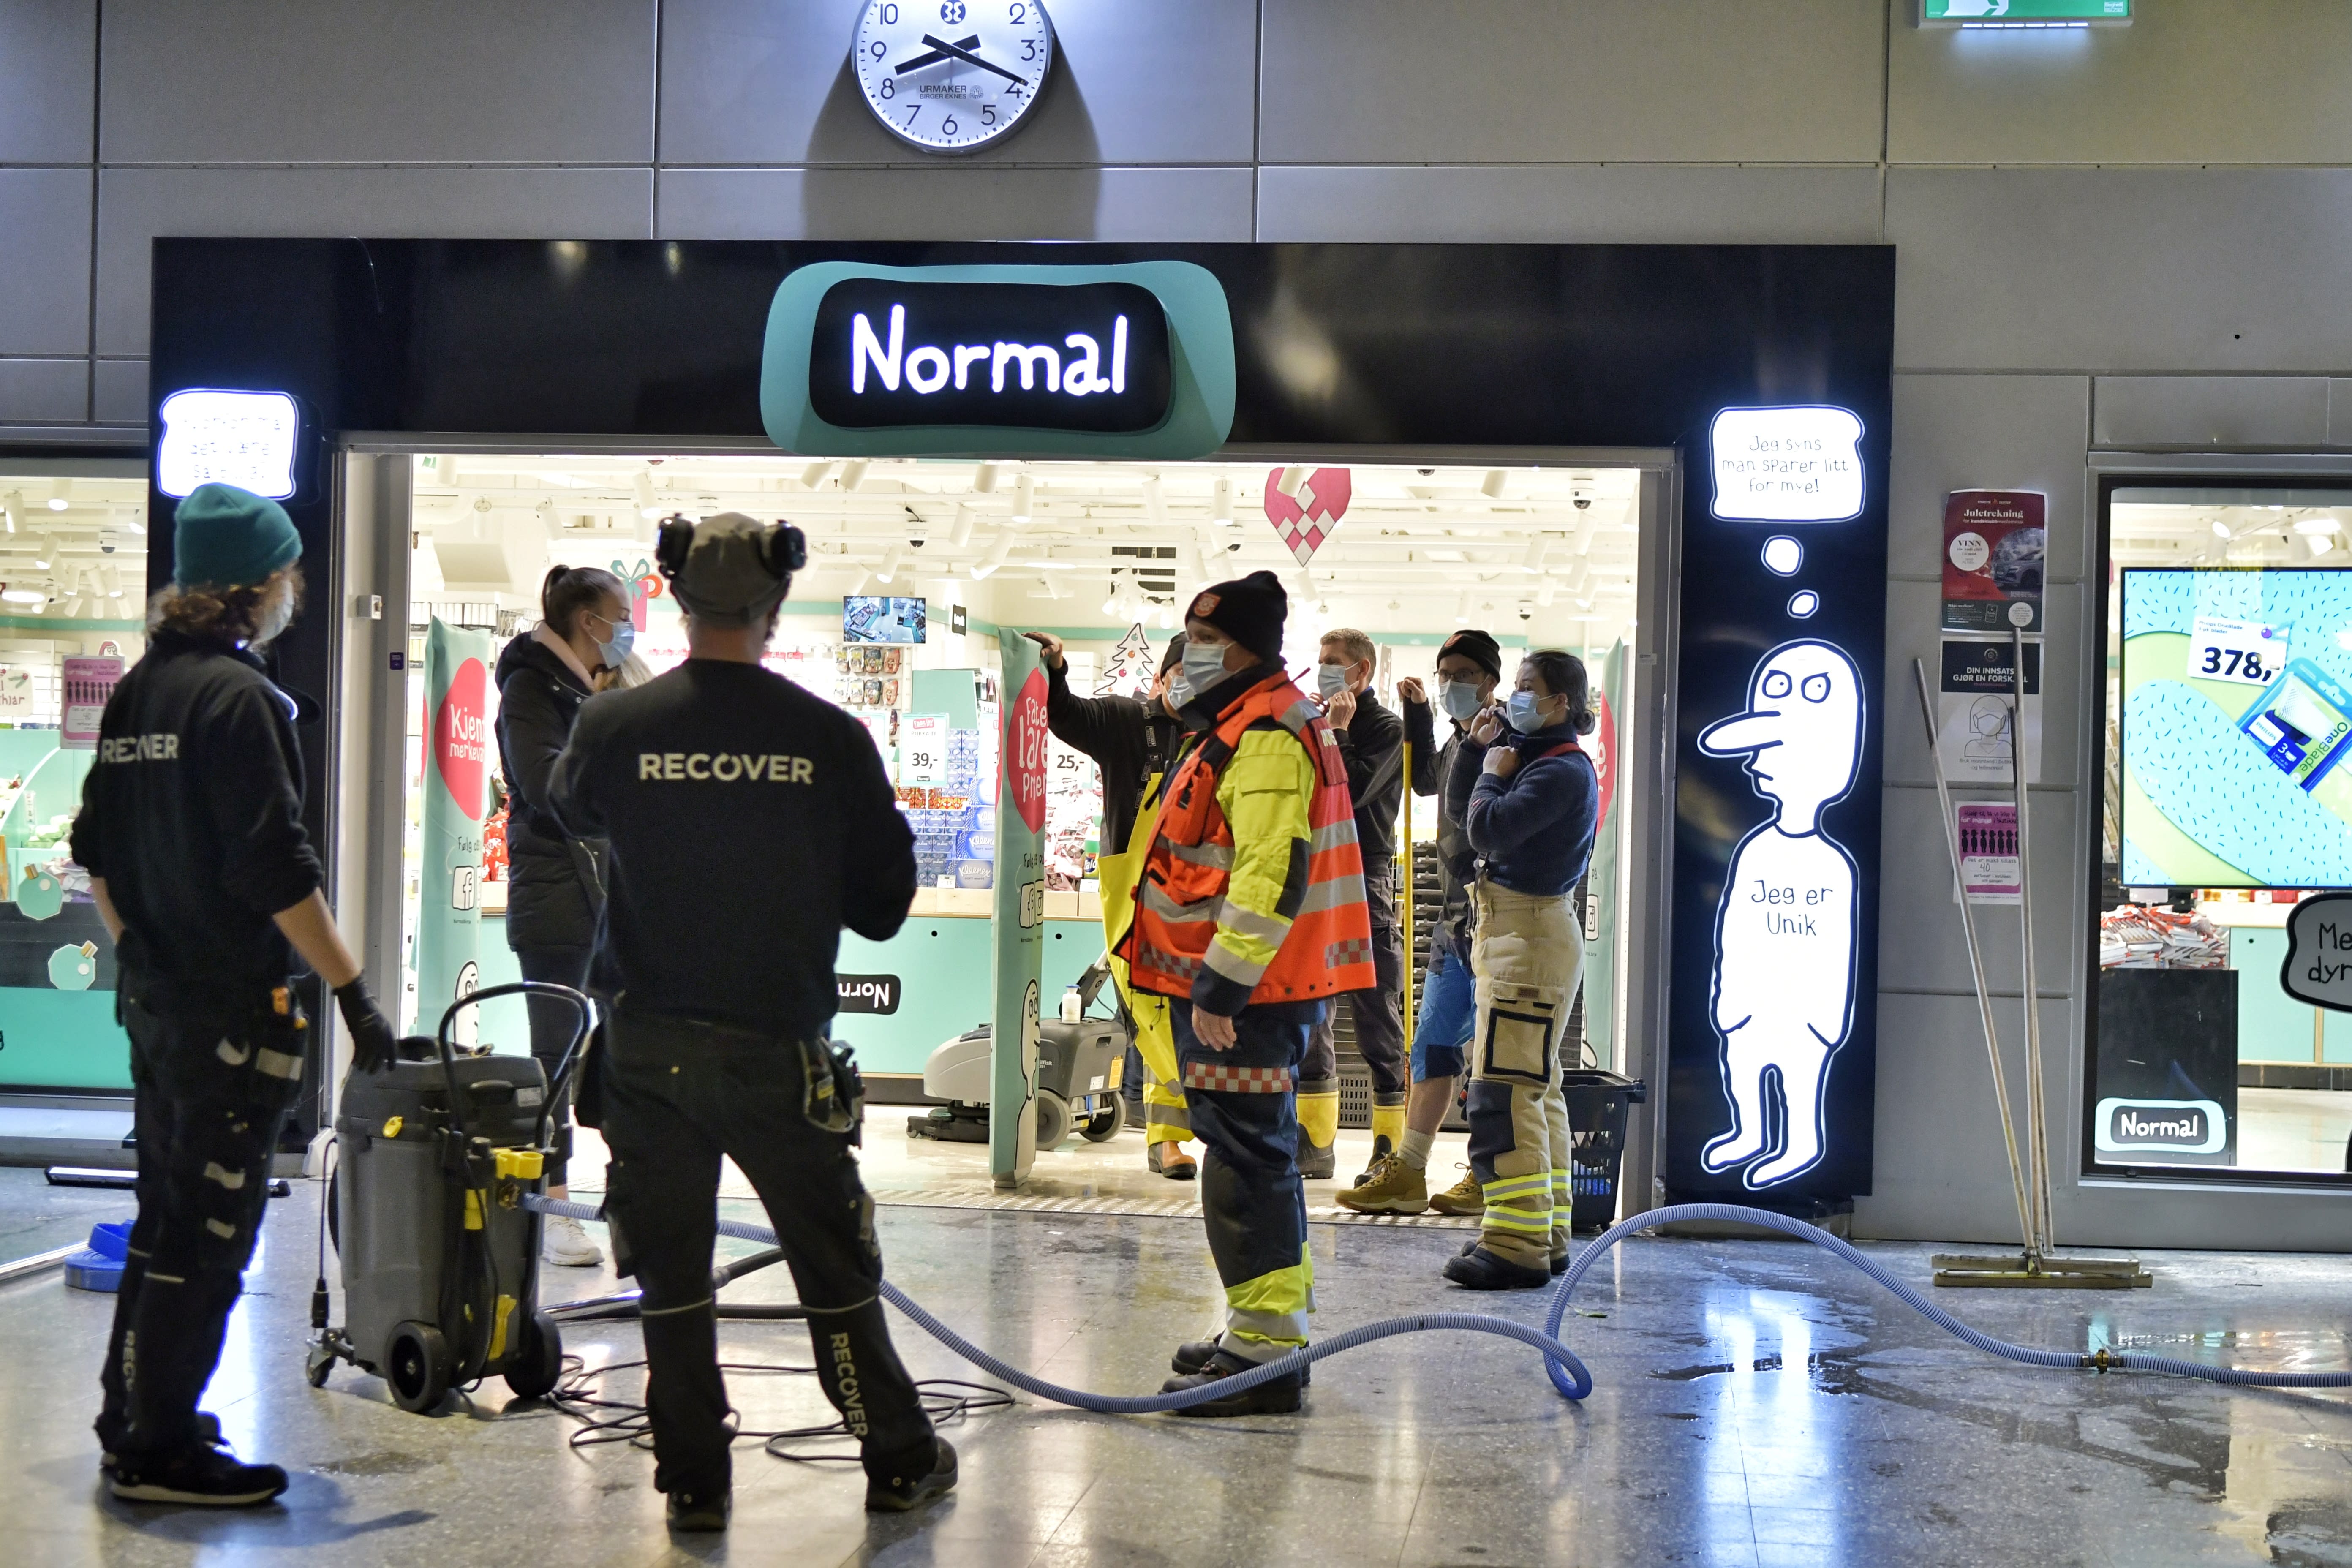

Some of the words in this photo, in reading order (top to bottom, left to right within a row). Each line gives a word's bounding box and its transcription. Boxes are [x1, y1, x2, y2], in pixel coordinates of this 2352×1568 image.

[880, 3, 898, 25] 10
[1009, 3, 1025, 24] 2
[871, 41, 887, 63] 9
[1021, 39, 1035, 61] 3
[881, 78, 895, 99] 8
[1004, 80, 1023, 98] 4
[906, 105, 922, 125] 7
[942, 114, 957, 135] 6
[981, 105, 996, 125] 5
[852, 303, 1128, 396] Normal
[1750, 435, 1779, 452] Jeg
[1786, 438, 1821, 452] syns
[1722, 459, 1755, 472] man
[1824, 458, 1849, 472] litt
[1749, 478, 1773, 492] for
[1781, 479, 1819, 493] mye!
[1964, 509, 2023, 519] Juletrekning
[2202, 647, 2280, 682] 378,-
[2256, 721, 2276, 740] PHILIPS
[2277, 743, 2288, 753] 3
[2300, 722, 2347, 772] OneBlade
[639, 752, 814, 785] RECOVER
[912, 753, 938, 769] 39,-
[1057, 755, 1085, 772] 25,-
[458, 836, 472, 853] Følg
[958, 865, 991, 877] Kleenex
[1980, 863, 1990, 872] 40
[1751, 880, 1795, 904] Jeg
[1806, 887, 1833, 905] er
[1767, 912, 1816, 936] Unik
[2319, 923, 2352, 950] Me
[2308, 956, 2352, 984] dyr
[2121, 1111, 2198, 1138] Normal
[830, 1332, 868, 1437] RECOVER
